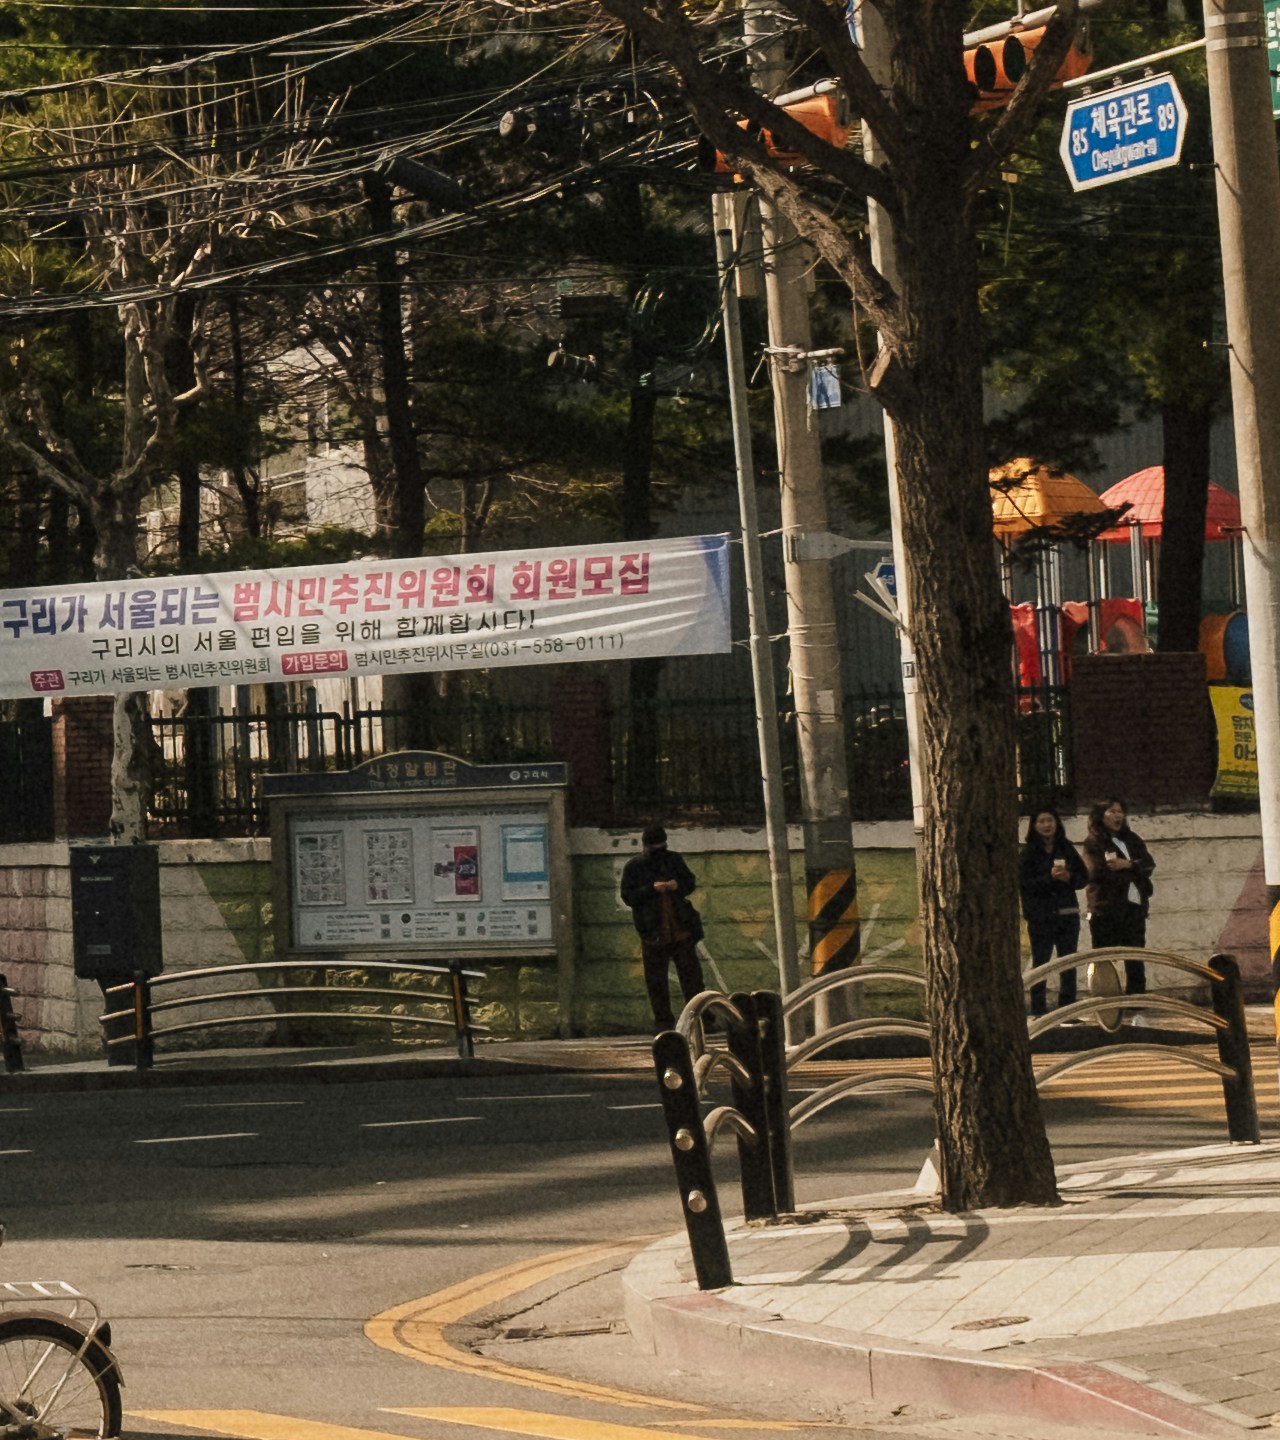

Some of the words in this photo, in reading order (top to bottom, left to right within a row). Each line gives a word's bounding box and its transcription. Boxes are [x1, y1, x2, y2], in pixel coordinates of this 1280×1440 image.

[1090, 92, 1153, 141] 체육관로
[1157, 102, 1176, 132] 89
[1071, 127, 1089, 157] 85
[2, 594, 88, 639] 구리가
[98, 586, 220, 631] 서울되는
[232, 563, 496, 623] 범시민추진위원회
[509, 552, 651, 601] 회원모집
[91, 633, 180, 661] 구리시의
[193, 629, 238, 652] 서울
[250, 622, 321, 649] 편입을
[335, 619, 382, 643] 위해
[32, 671, 61, 688] 주관
[67, 670, 106, 687] 구리가
[110, 665, 162, 684] 서울되는
[165, 657, 271, 679] 범시민추진위원회
[285, 651, 347, 672] 가입문의
